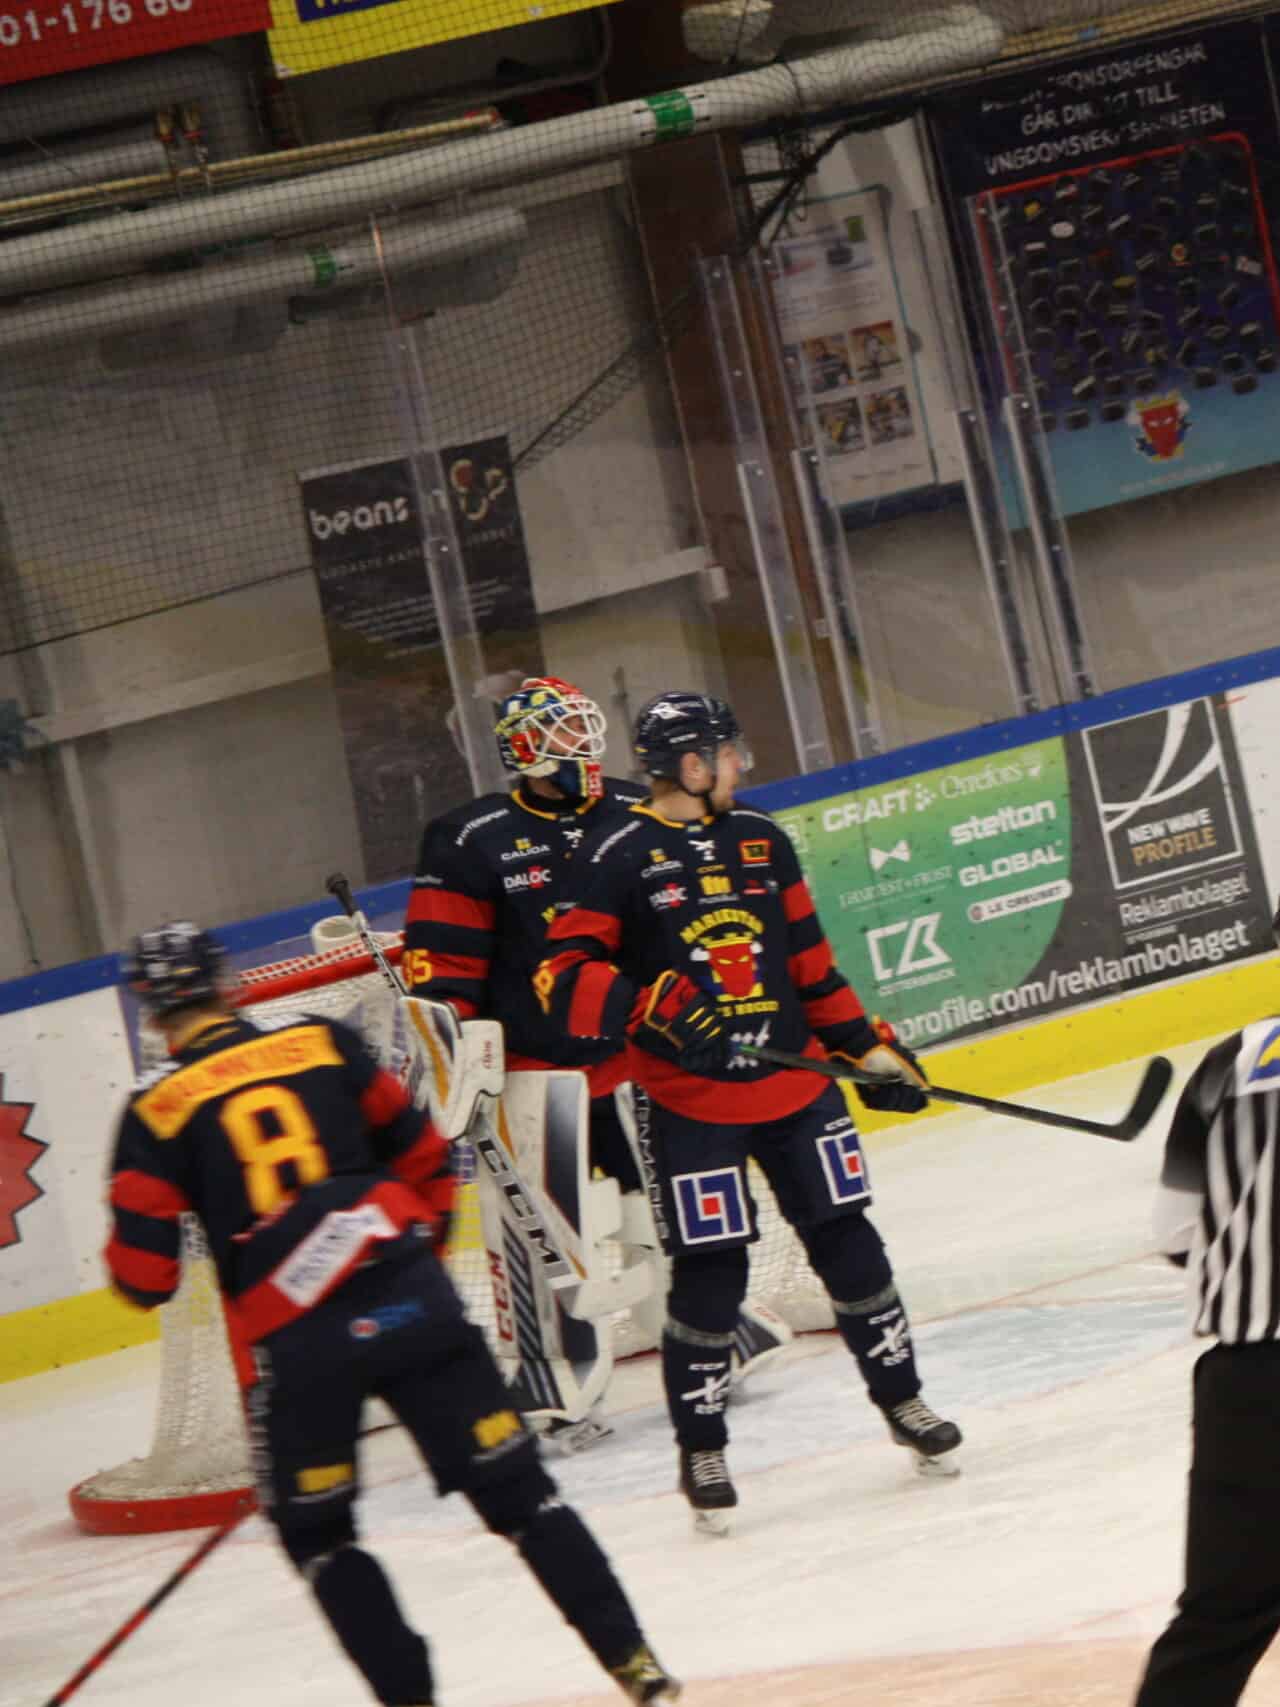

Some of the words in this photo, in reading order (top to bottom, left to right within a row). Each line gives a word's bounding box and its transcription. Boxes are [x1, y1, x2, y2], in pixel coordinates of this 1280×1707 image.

[1136, 81, 1180, 105] TILL
[308, 496, 409, 540] beans
[823, 789, 911, 832] CRAFT
[950, 800, 1057, 846] stelton
[1127, 820, 1166, 845] NEW
[1167, 808, 1212, 834] WAVE
[958, 845, 1064, 888] GLOBAL
[1131, 827, 1217, 867] PROFILE
[503, 868, 553, 889] DALOC
[1119, 873, 1250, 927] Reklambolaget
[219, 1084, 331, 1214] 8
[486, 1248, 514, 1343] CCM
